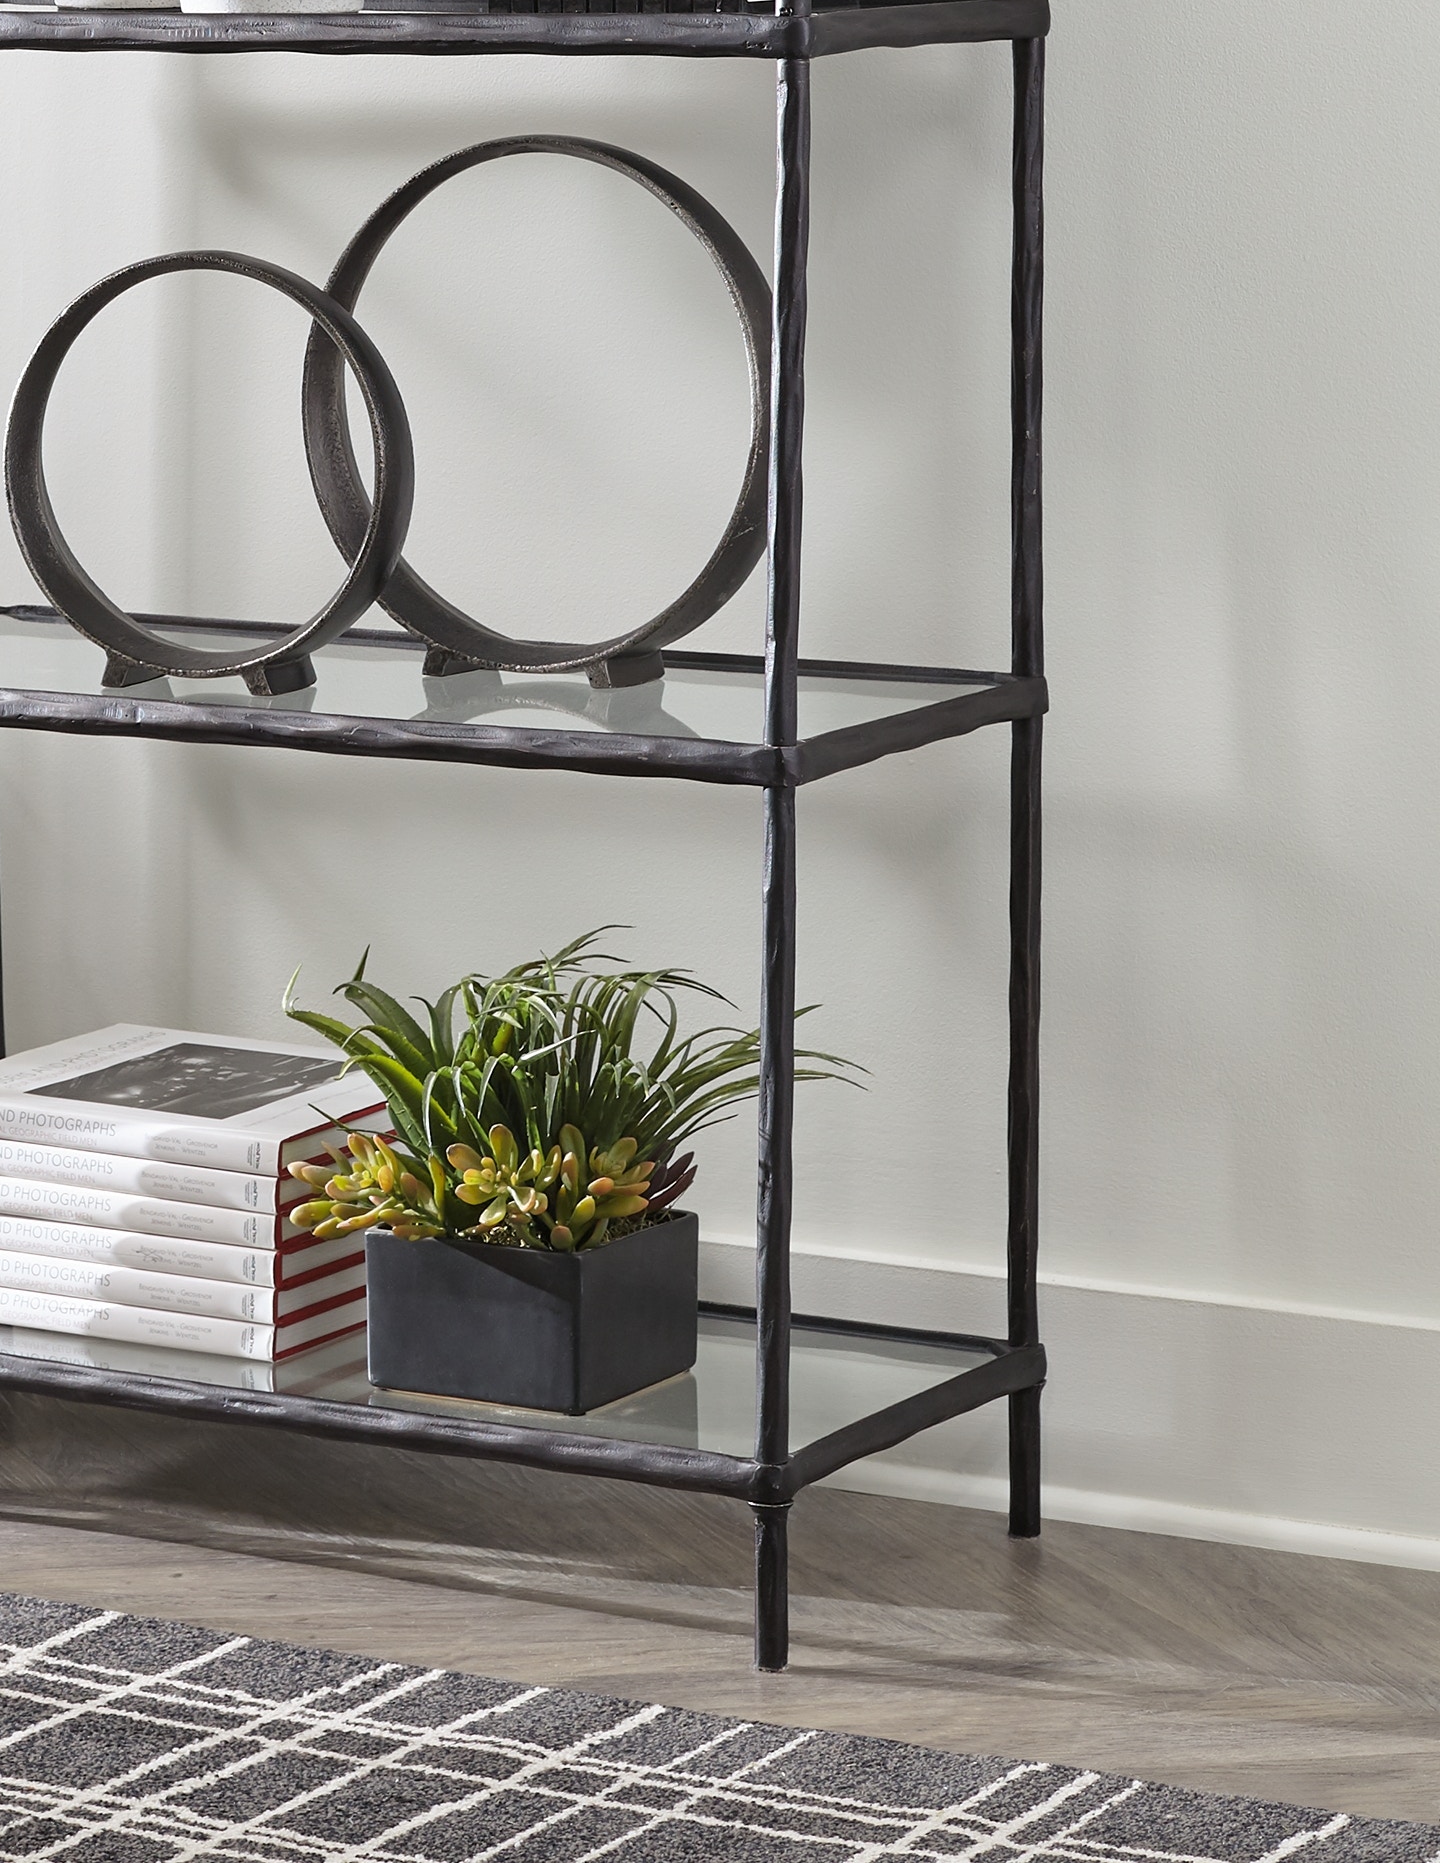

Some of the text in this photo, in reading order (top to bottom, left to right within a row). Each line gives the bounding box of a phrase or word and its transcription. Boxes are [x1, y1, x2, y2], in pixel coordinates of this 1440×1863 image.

[18, 1111, 117, 1137] PHOTOGRAPHS
[16, 1148, 114, 1175] PHOTOGRAPHS
[13, 1186, 112, 1212] PHOTOGRAPHS
[15, 1223, 113, 1249] PHOTOGRAPHS
[14, 1260, 111, 1287] PHOTOGRAPHS
[13, 1294, 111, 1321] PHOTOGRAPHS
